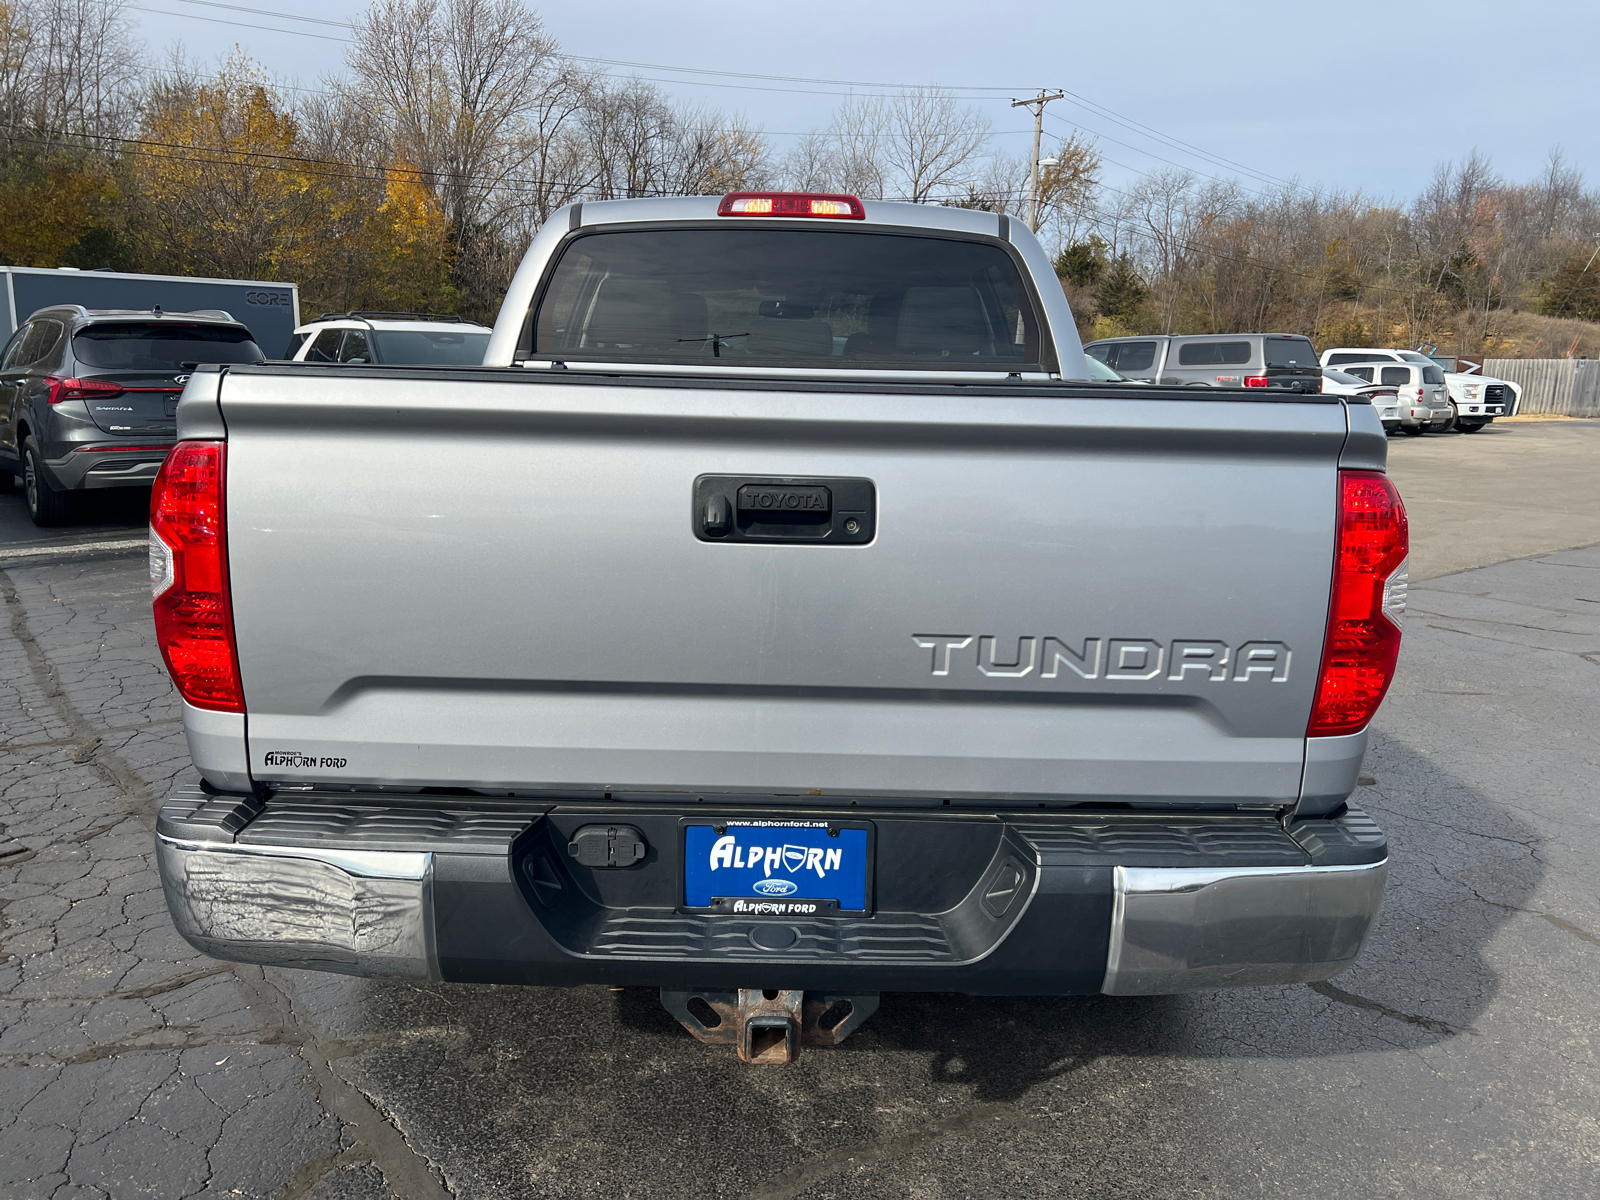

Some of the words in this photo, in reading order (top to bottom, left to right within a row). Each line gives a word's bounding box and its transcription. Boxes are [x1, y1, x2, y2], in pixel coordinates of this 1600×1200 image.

[246, 291, 290, 306] CORE
[746, 493, 825, 509] TOYOTA
[912, 634, 1292, 682] TUNDRA
[264, 751, 317, 768] ALPHORN
[319, 757, 347, 769] FORD
[726, 820, 829, 828] www.alphornford.net
[710, 835, 842, 878] ALPHORN
[762, 882, 788, 893] Ford
[733, 900, 785, 915] ALPHORN
[788, 903, 816, 913] FORD
